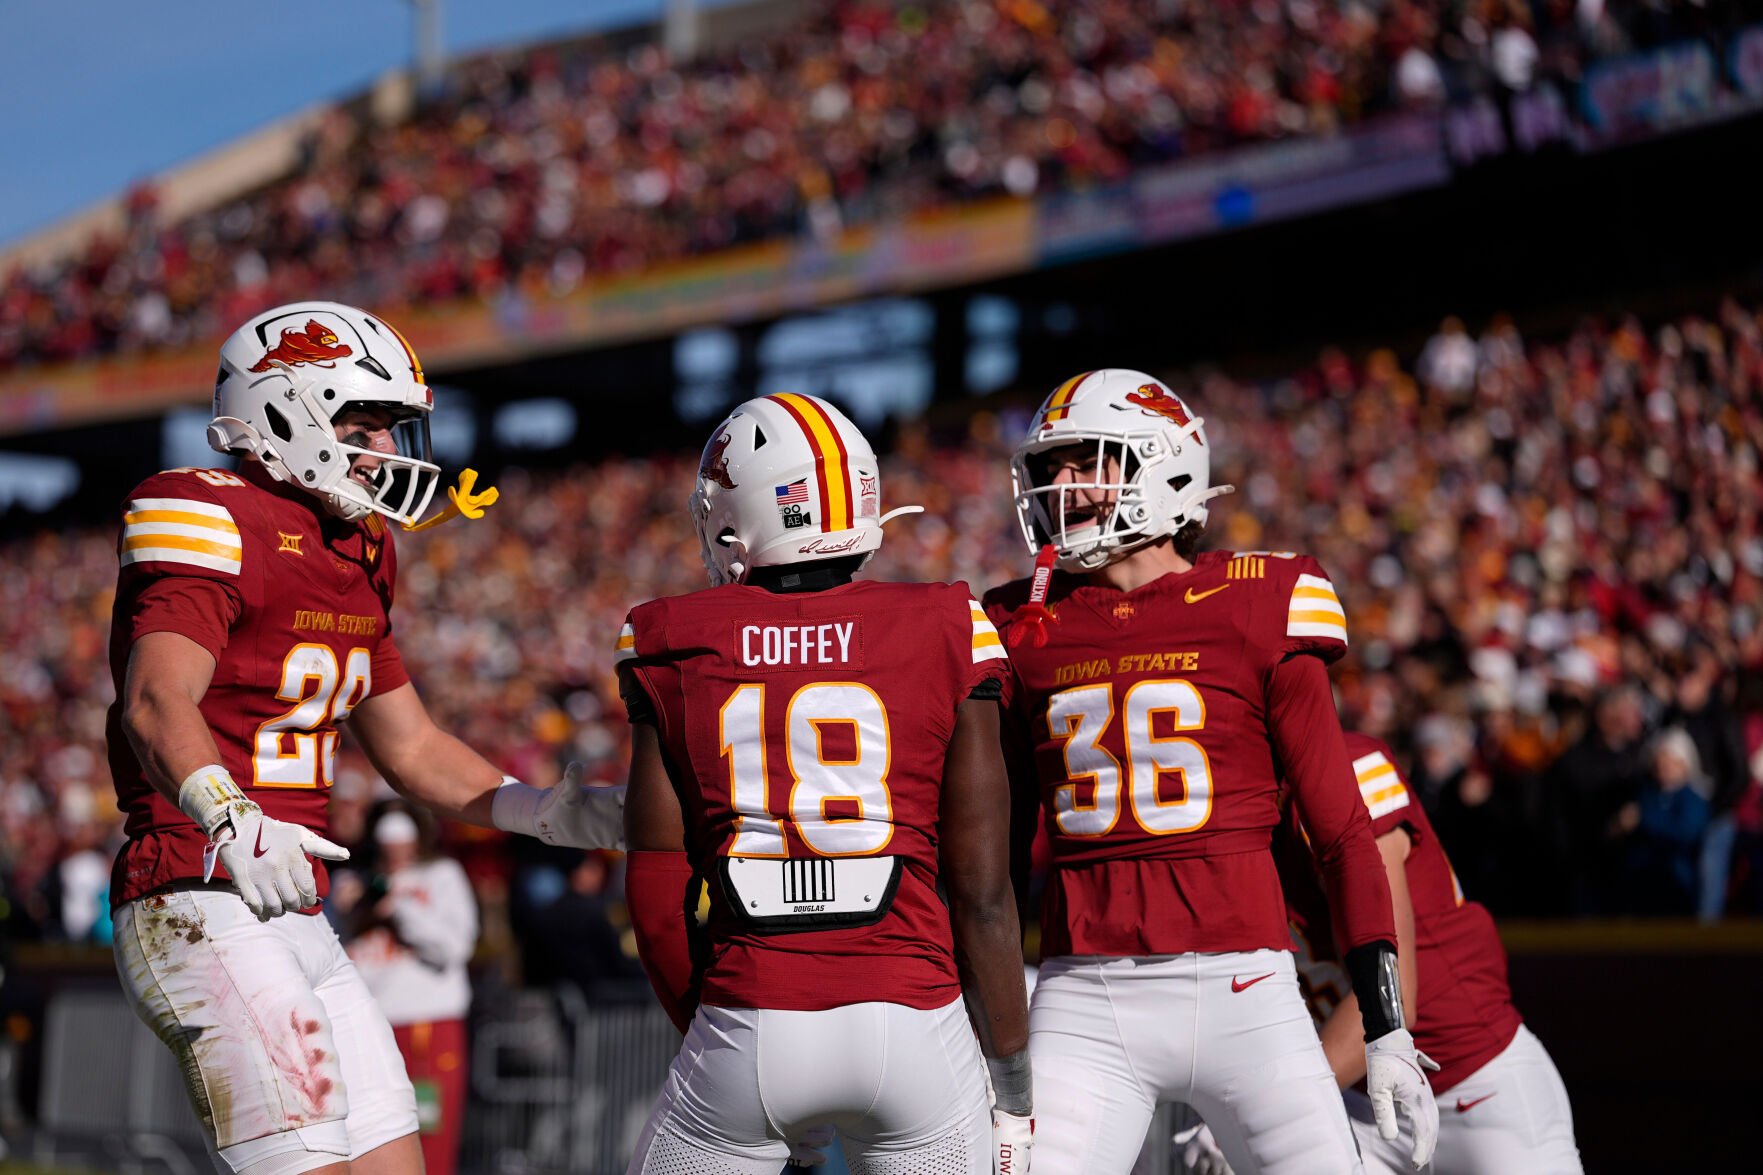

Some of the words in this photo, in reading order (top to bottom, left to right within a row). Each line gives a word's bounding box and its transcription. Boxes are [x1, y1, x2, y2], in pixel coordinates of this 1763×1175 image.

[787, 515, 802, 526] AE
[1030, 566, 1050, 602] NXTRND
[293, 610, 335, 632] IOWA
[337, 614, 377, 635] STATE
[742, 621, 854, 667] COFFEY
[1055, 659, 1111, 685] IOWA
[1116, 651, 1200, 673] STATE
[719, 681, 894, 858] 18
[1047, 679, 1213, 836] 36
[793, 904, 825, 913] DOUGLAS
[1000, 1143, 1012, 1175] IOW
